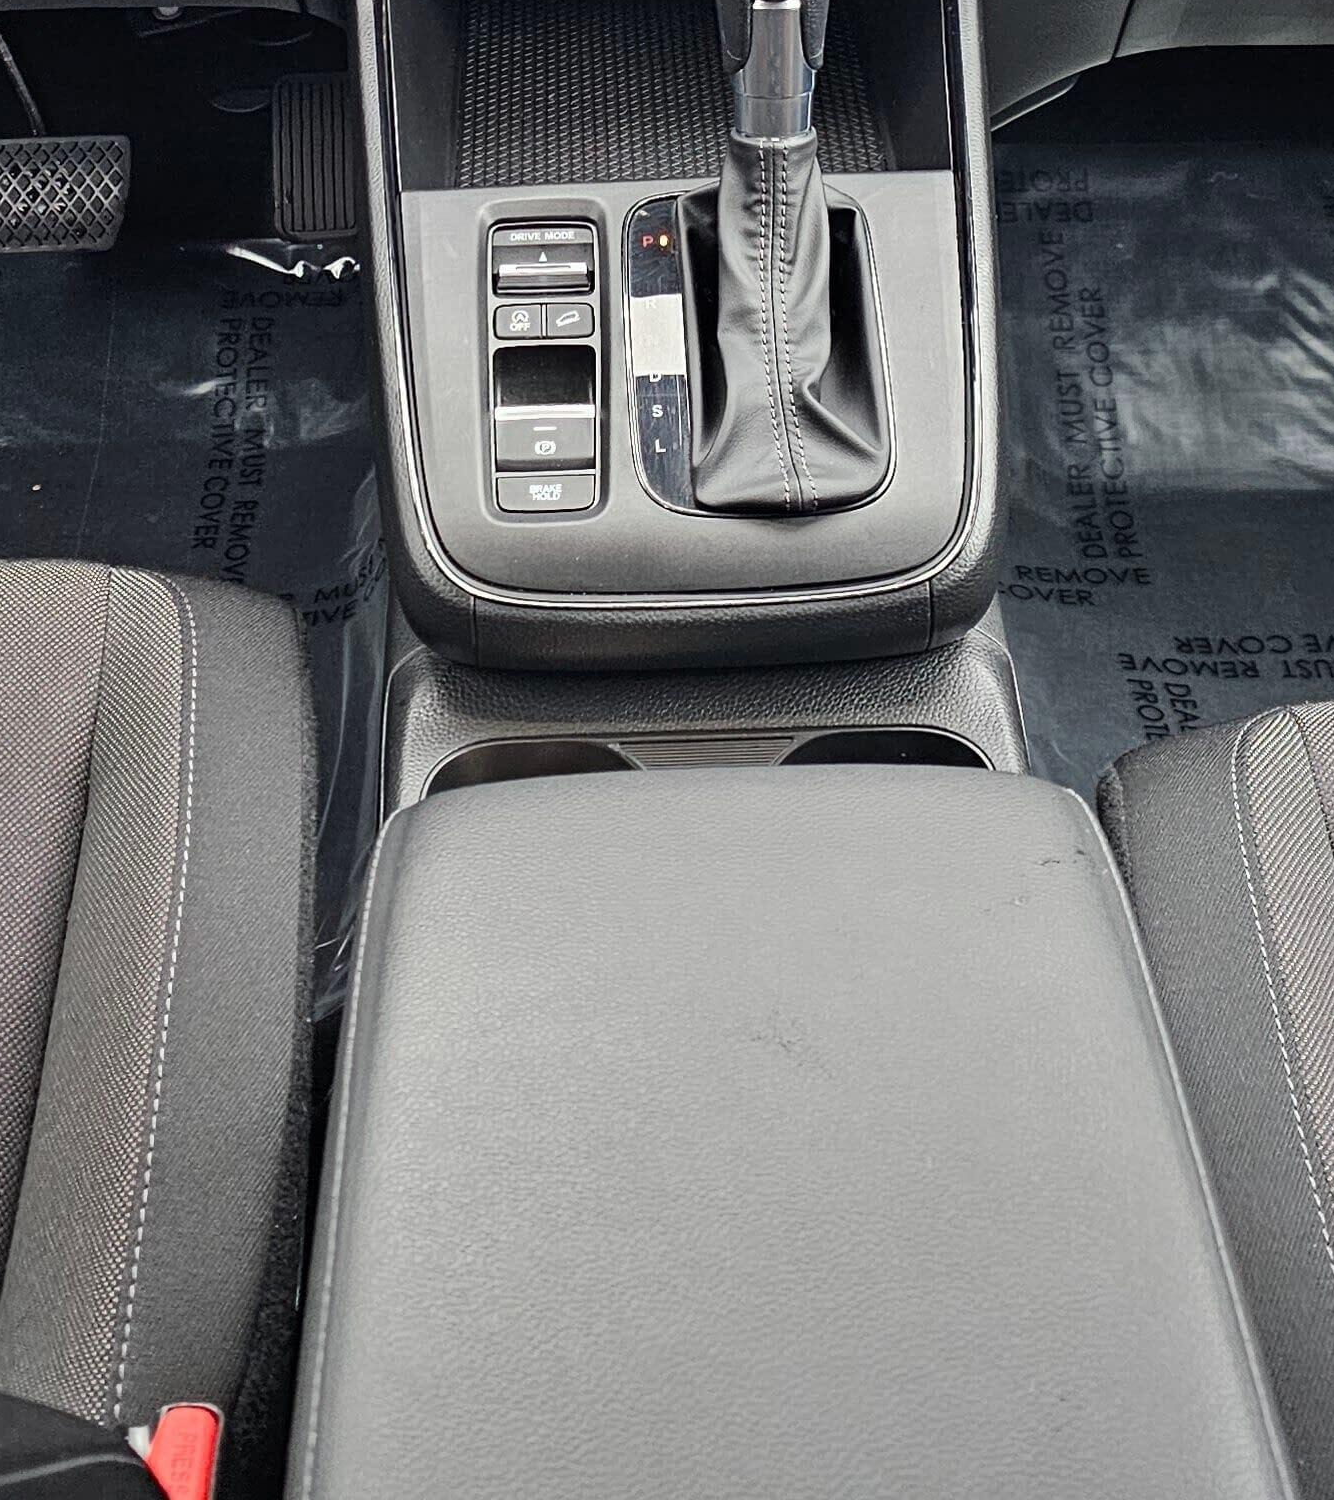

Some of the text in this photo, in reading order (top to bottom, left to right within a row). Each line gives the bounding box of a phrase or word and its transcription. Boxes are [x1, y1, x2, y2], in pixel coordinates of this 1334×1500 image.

[510, 231, 575, 241] DRIVE MODE
[642, 235, 654, 248] P
[510, 323, 530, 332] OFF
[237, 316, 276, 487] DEALER MUST
[1040, 230, 1109, 559] DEALER MUST REMOVE
[652, 405, 663, 417] S
[1078, 285, 1144, 560] PROTECTIVE COVER
[190, 316, 245, 550] PROTECTIVE COVER
[655, 439, 666, 453] L
[529, 484, 562, 494] BRAKE
[533, 491, 560, 501] HOLD
[1015, 563, 1153, 587] REMOVE
[1173, 634, 1294, 656] COVER
[1116, 652, 1262, 679] REMOVE
